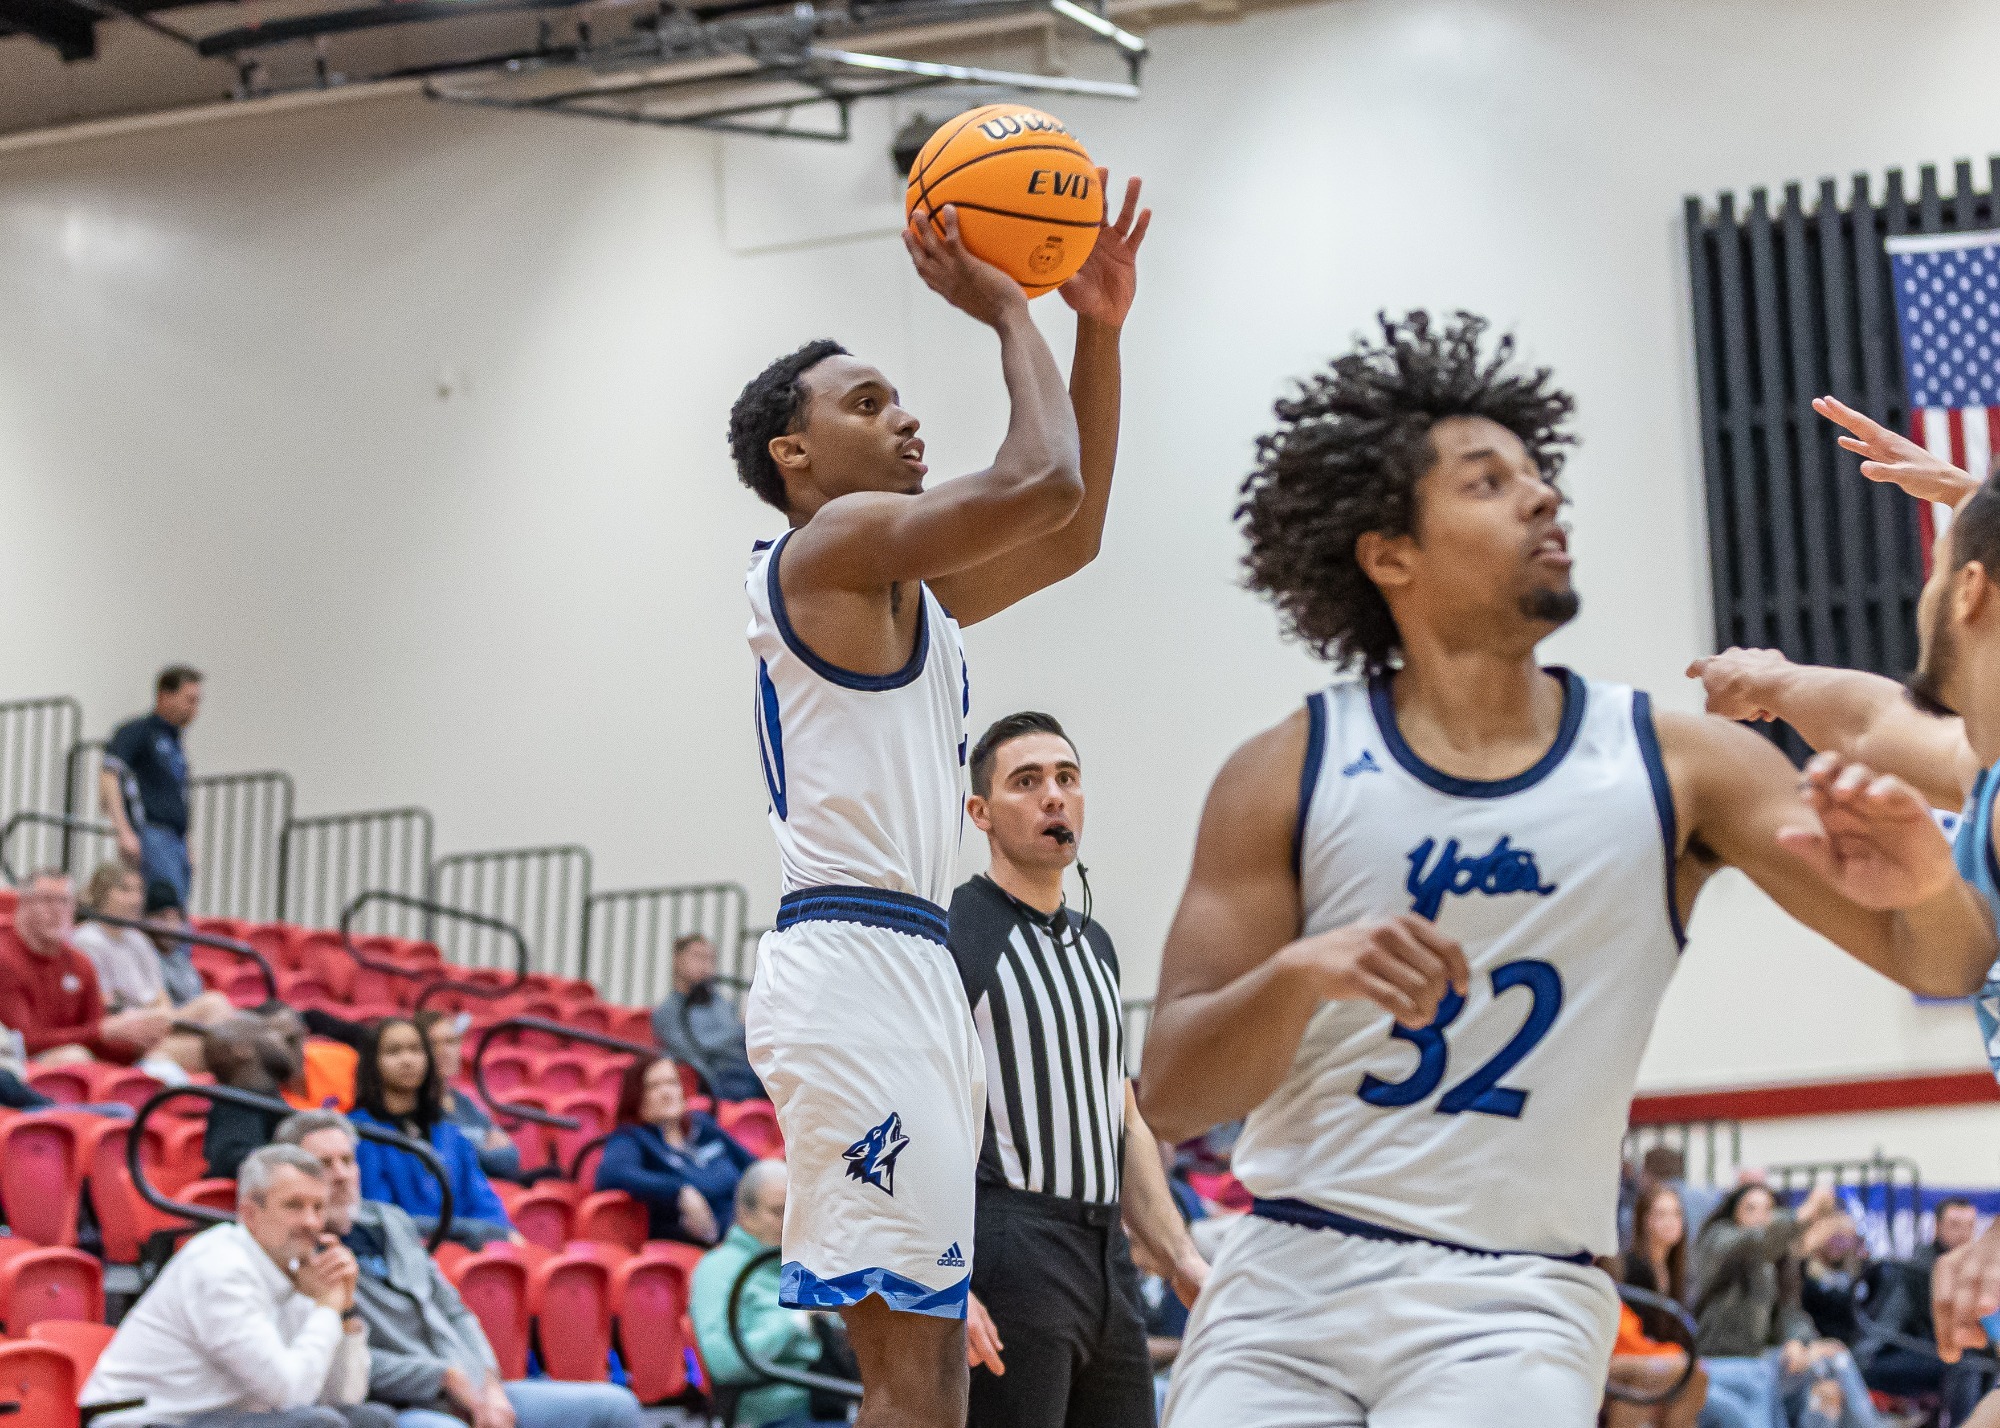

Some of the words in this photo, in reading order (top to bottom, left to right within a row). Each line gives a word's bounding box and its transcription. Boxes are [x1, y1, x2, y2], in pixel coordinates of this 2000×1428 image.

[1027, 169, 1090, 200] EVO
[1357, 959, 1563, 1120] 32
[937, 1257, 965, 1267] adidas
